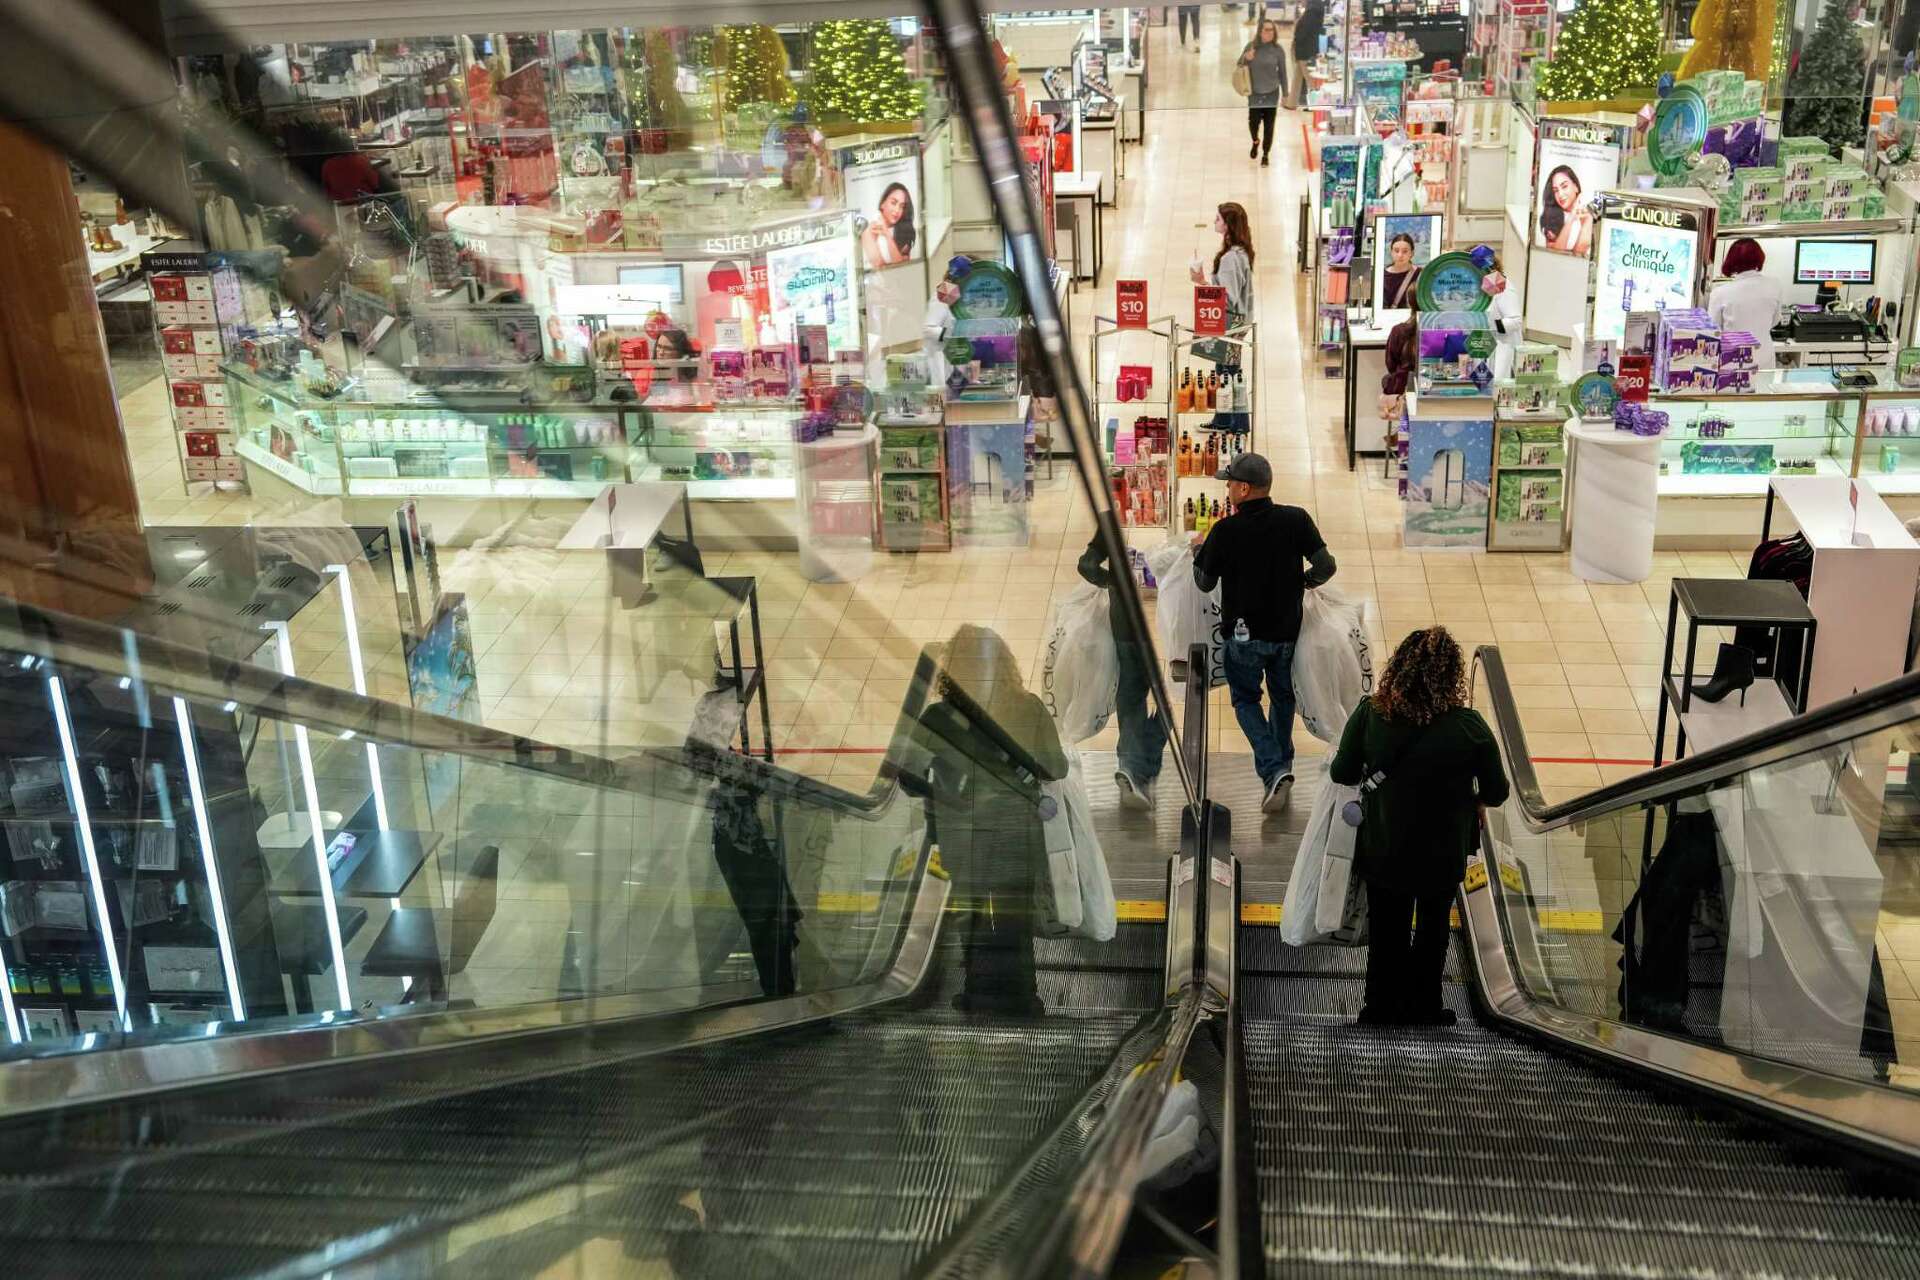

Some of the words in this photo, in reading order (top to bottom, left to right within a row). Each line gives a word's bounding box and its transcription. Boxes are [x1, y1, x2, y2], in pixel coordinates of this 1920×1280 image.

[1557, 127, 1608, 144] CLINIQUE
[1621, 206, 1682, 228] CLINIQUE
[1630, 242, 1669, 263] Merry
[1622, 253, 1675, 274] Clinique
[1121, 301, 1144, 313] $10
[1199, 307, 1222, 320] $10
[1627, 376, 1645, 389] 20
